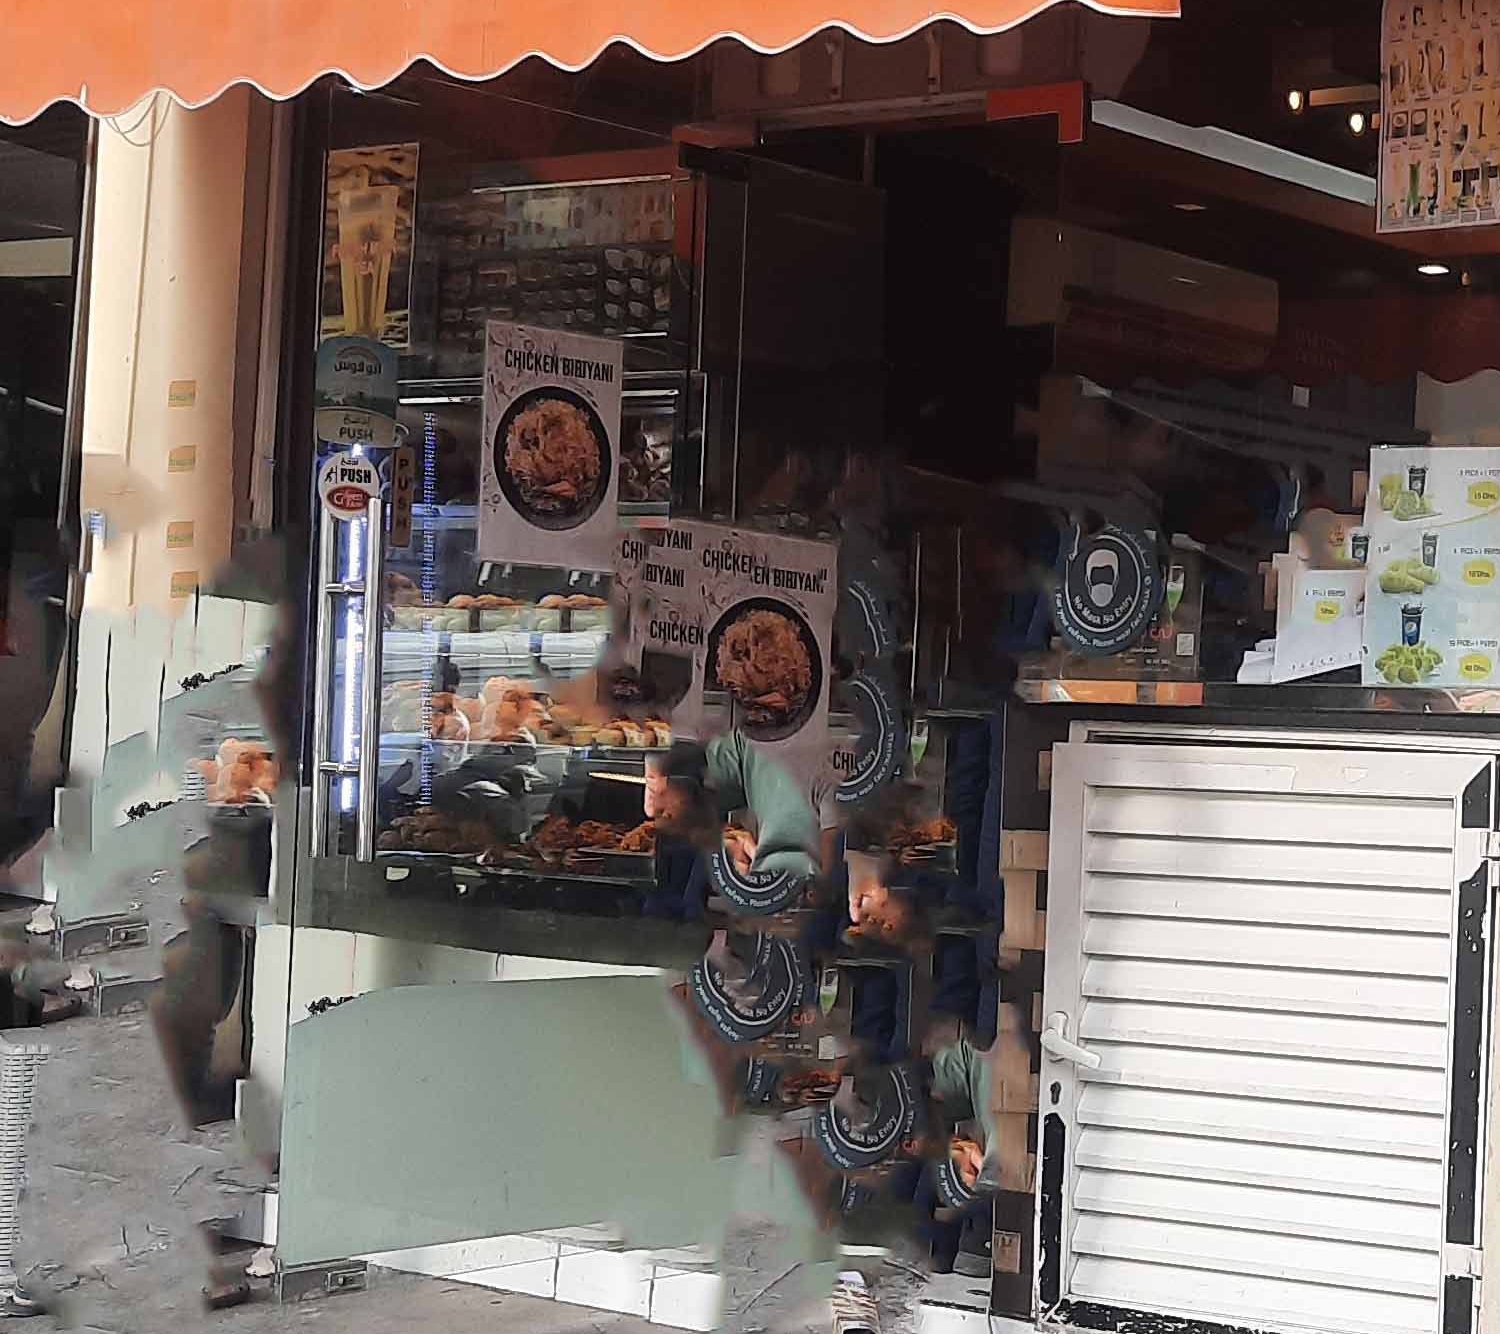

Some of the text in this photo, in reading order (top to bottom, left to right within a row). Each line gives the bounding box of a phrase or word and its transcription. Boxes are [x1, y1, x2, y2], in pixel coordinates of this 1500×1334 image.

[505, 349, 559, 375] CHICKEN
[339, 427, 374, 442] PUSH
[341, 468, 372, 485] PUSH
[650, 619, 704, 646] CHICKEN
